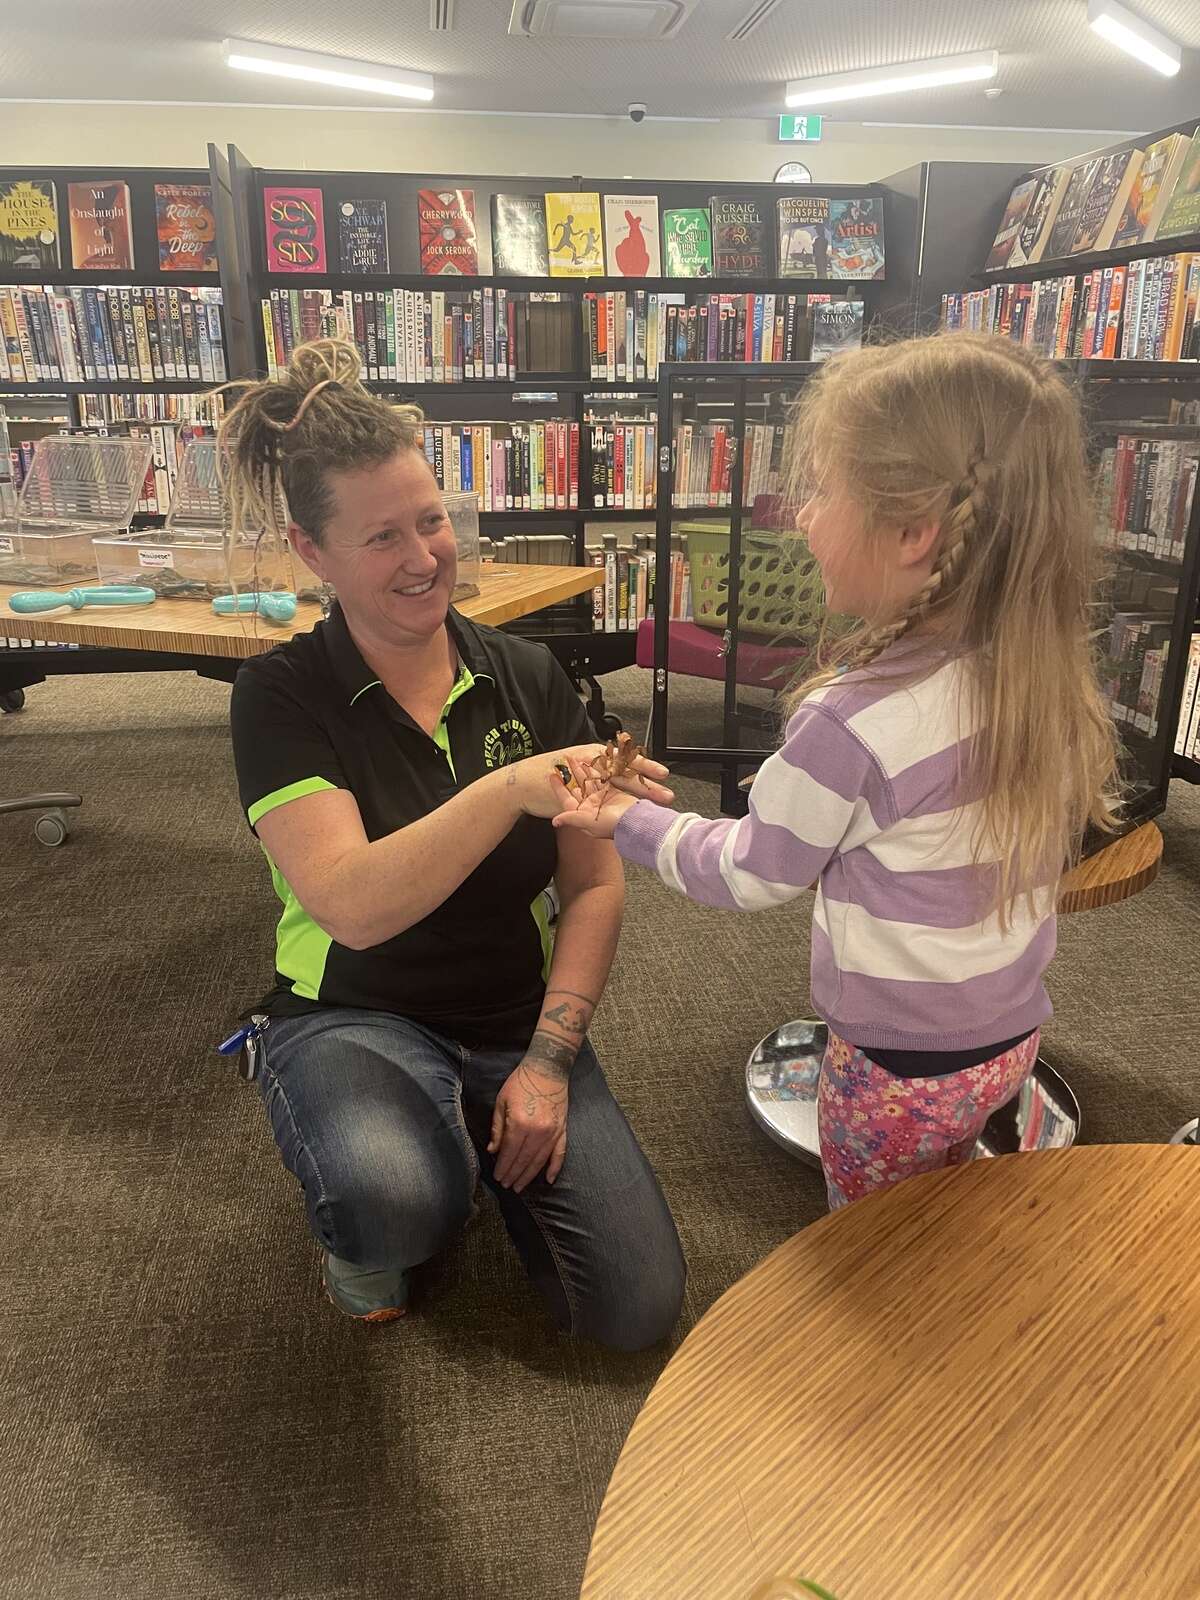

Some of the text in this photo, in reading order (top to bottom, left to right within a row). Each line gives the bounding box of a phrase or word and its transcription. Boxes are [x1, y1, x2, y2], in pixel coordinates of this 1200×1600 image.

[91, 189, 105, 199] An
[3, 198, 47, 209] HOUSE
[166, 203, 204, 221] Rebel
[722, 203, 755, 213] CRAIG
[783, 200, 828, 208] JACQUELINE
[72, 207, 125, 219] Onslaught
[341, 216, 385, 226] SCHWAB
[715, 214, 763, 224] RUSSELL
[783, 208, 829, 217] WINSPEAR
[7, 217, 47, 228] PINES
[675, 217, 701, 235] Cat
[837, 222, 880, 238] Artist
[94, 226, 105, 237] of
[87, 245, 115, 257] Light
[169, 235, 203, 257] Deep
[277, 242, 314, 263] SIN
[352, 249, 377, 258] ADDIE
[427, 246, 473, 256] JOCK SERONG
[111, 297, 121, 321] ROBB
[145, 297, 156, 321] ROBB
[169, 297, 179, 320] ROBB
[1139, 281, 1152, 339] BRAD THOR
[1155, 277, 1171, 337] BRAD THOR
[136, 315, 145, 338] ROBB
[821, 314, 856, 324] SIMON
[199, 321, 208, 343] ROBB
[386, 323, 395, 353] TRAITOR
[368, 337, 377, 364] ANOMALY
[592, 463, 600, 485] HEART
[484, 728, 501, 768] DUTCH
